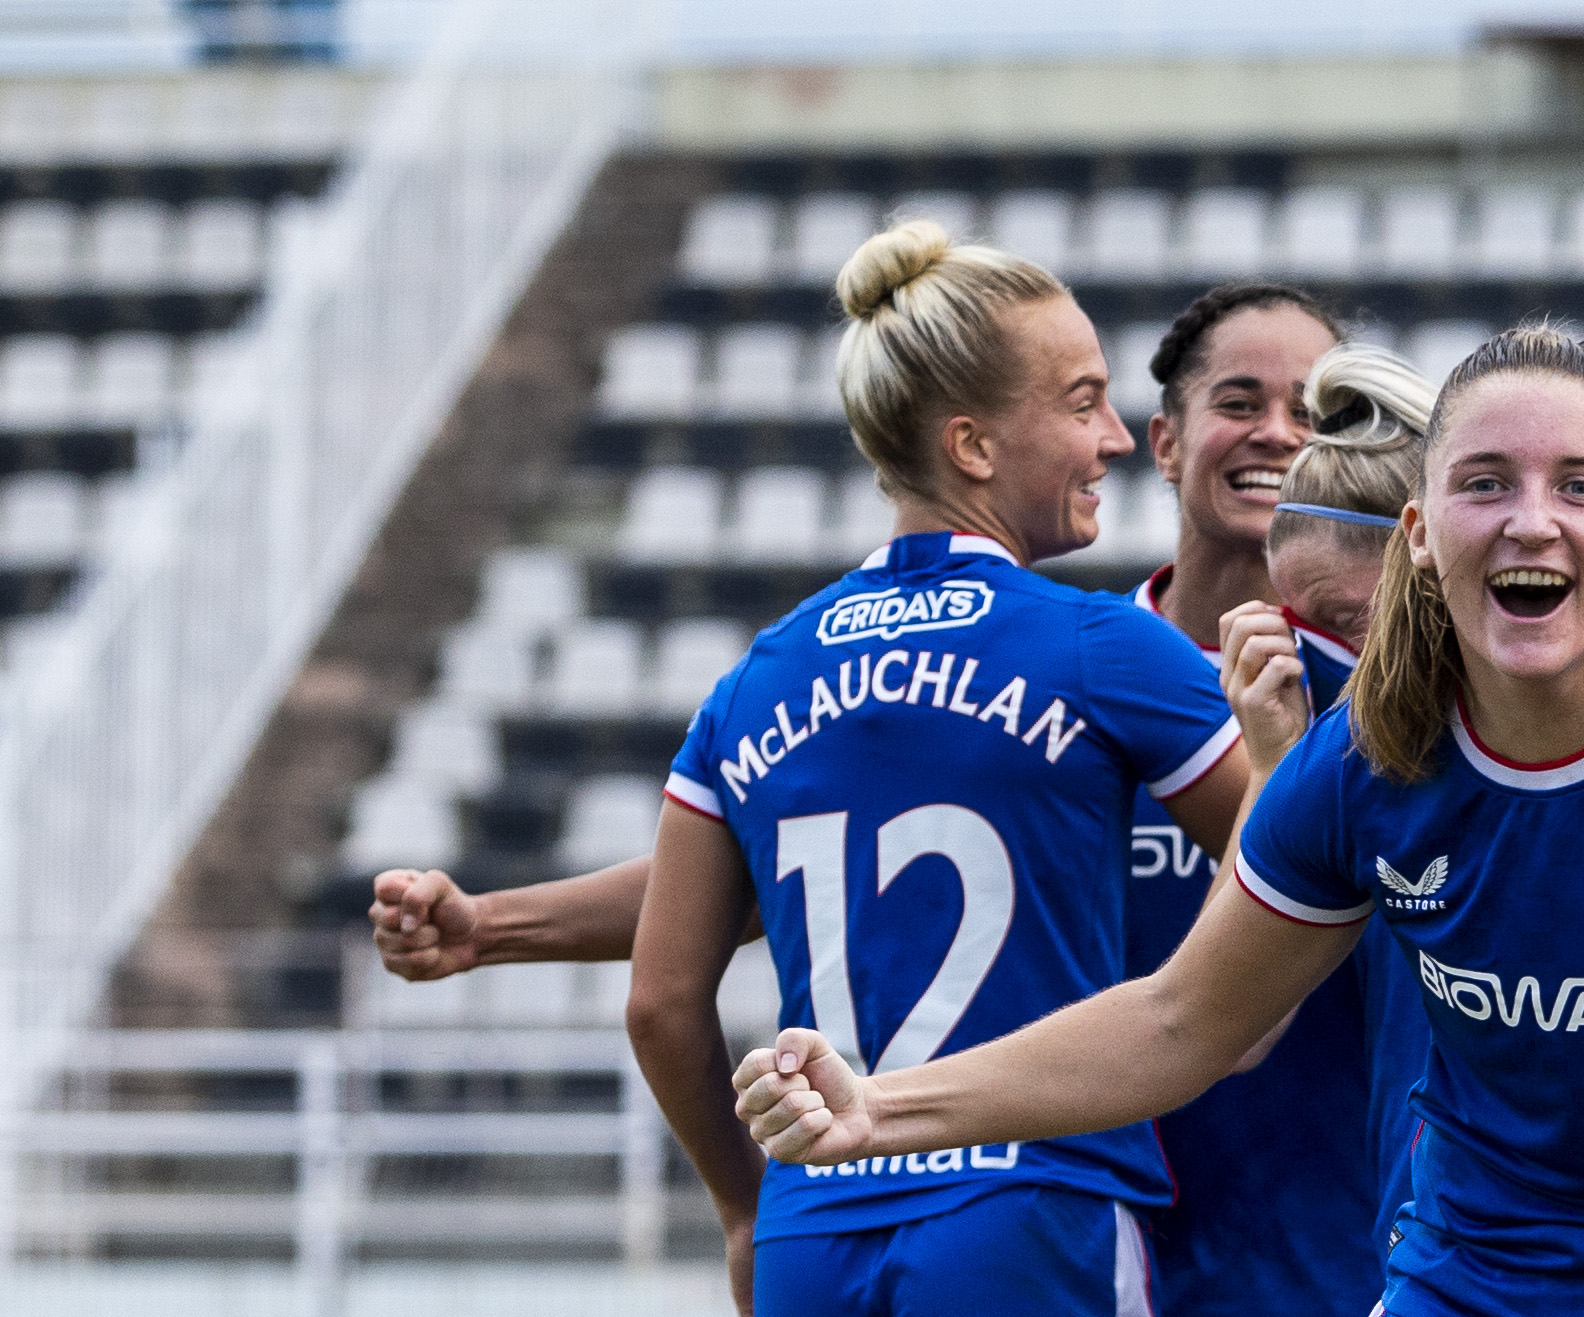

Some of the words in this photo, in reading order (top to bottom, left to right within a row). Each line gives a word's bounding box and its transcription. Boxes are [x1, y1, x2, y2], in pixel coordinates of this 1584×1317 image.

[831, 588, 976, 635] FRIDAYS
[719, 649, 1087, 805] McLAUCHLAN
[776, 803, 1016, 1076] 12
[1385, 897, 1448, 911] CASTORE
